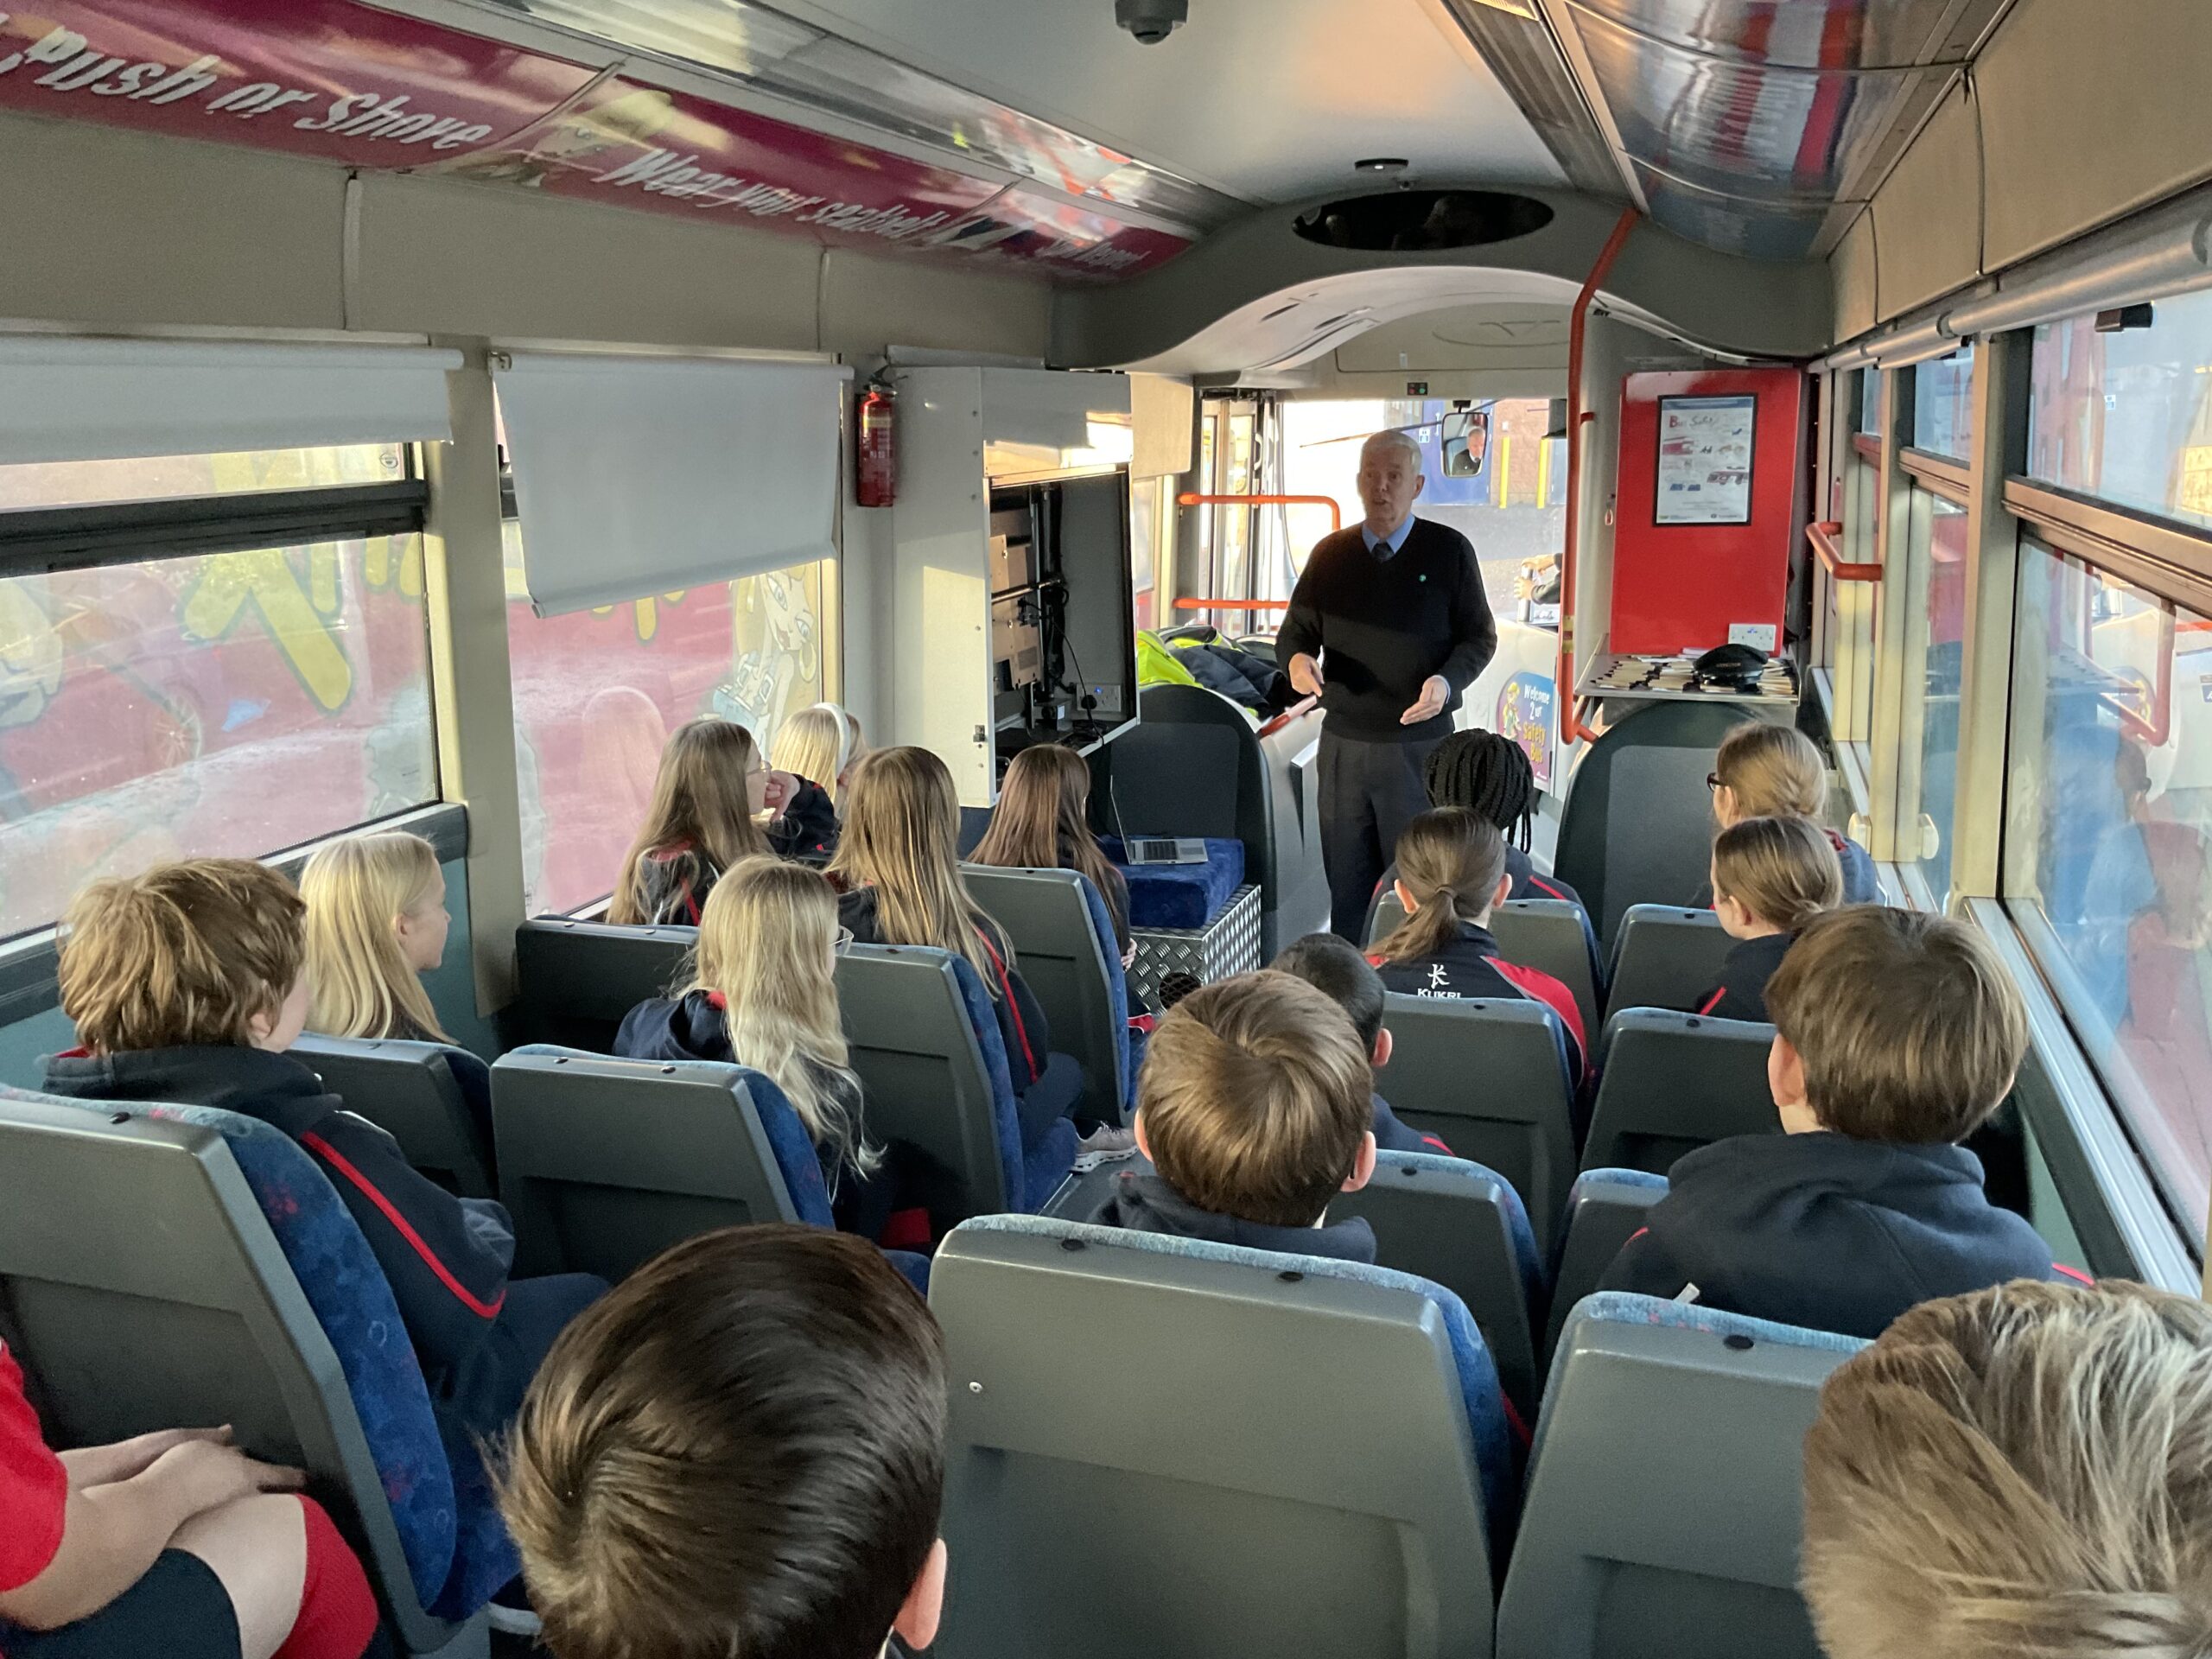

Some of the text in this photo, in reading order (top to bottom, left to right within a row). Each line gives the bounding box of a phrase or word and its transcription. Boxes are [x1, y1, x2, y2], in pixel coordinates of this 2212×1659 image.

[25, 25, 221, 105] Push
[206, 83, 317, 118] or
[294, 93, 493, 149] Shove
[590, 148, 745, 200] Wear
[696, 183, 826, 216] your
[1523, 684, 1550, 705] Welcome
[1529, 702, 1535, 721] 2
[1522, 721, 1546, 747] Safety
[1530, 743, 1543, 764] Bus
